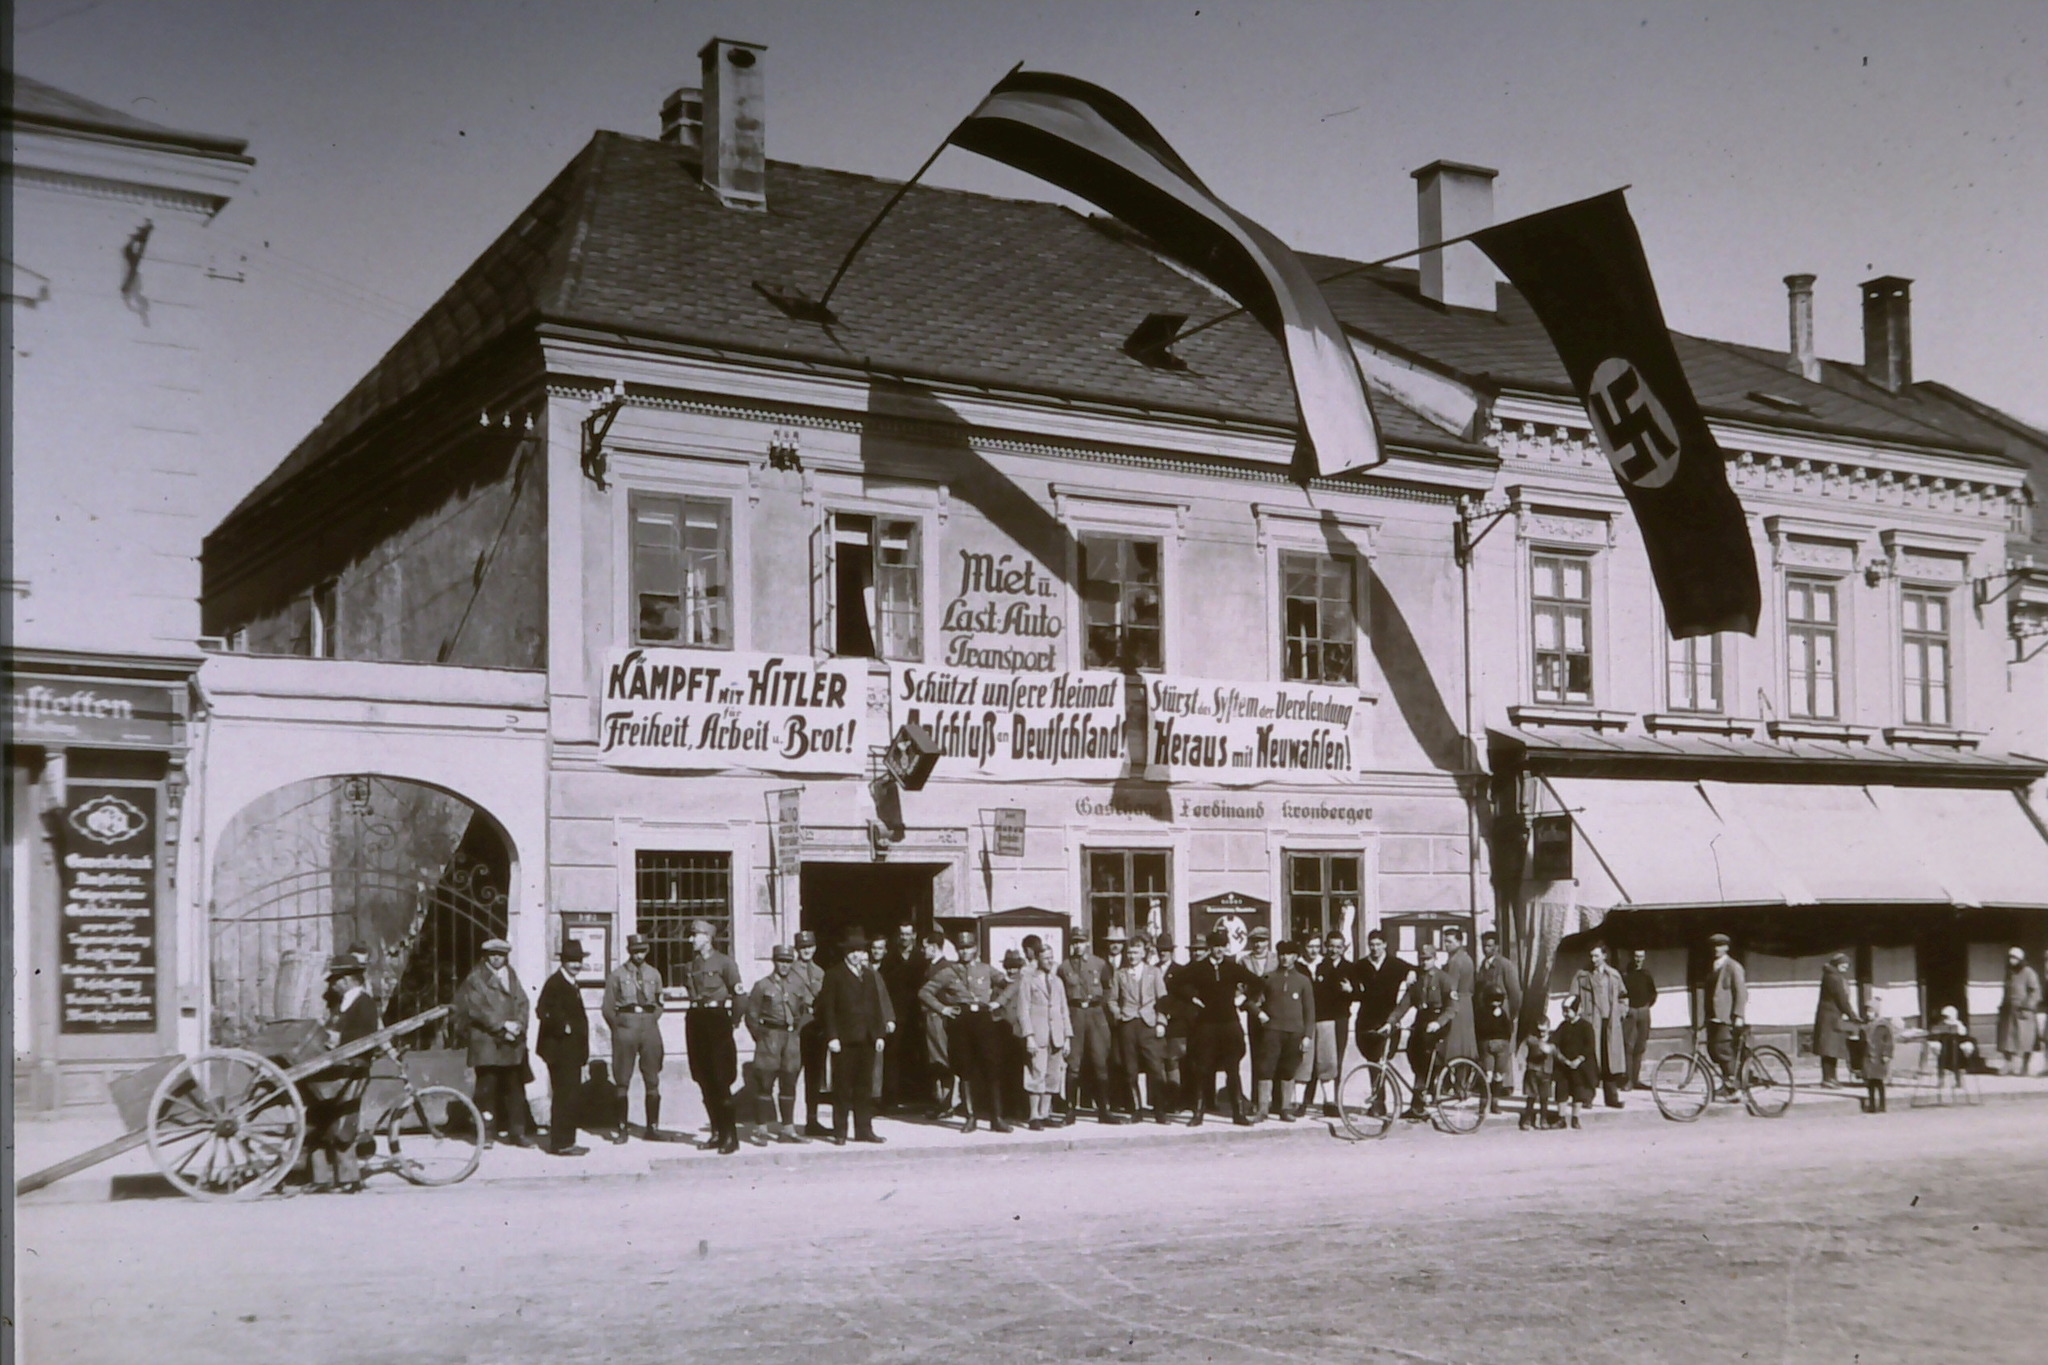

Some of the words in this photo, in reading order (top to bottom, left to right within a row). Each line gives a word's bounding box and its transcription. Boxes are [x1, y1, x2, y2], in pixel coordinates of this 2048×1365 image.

[959, 549, 1036, 598] Miet
[940, 599, 997, 633] Last
[945, 633, 1056, 675] Transport
[748, 658, 847, 708] HITLER
[900, 669, 979, 706] Schützt
[1050, 672, 1118, 709] Heimat
[1151, 680, 1199, 718] Stürzt
[1275, 690, 1353, 730] Verelendung
[602, 710, 693, 753] Freiheit,
[696, 712, 770, 751] Arbeit
[779, 715, 856, 760] Brot!
[723, 707, 742, 719] für
[1154, 716, 1227, 767] Heraus
[1231, 745, 1254, 768] mit
[1256, 723, 1352, 771] Neuwahlen!
